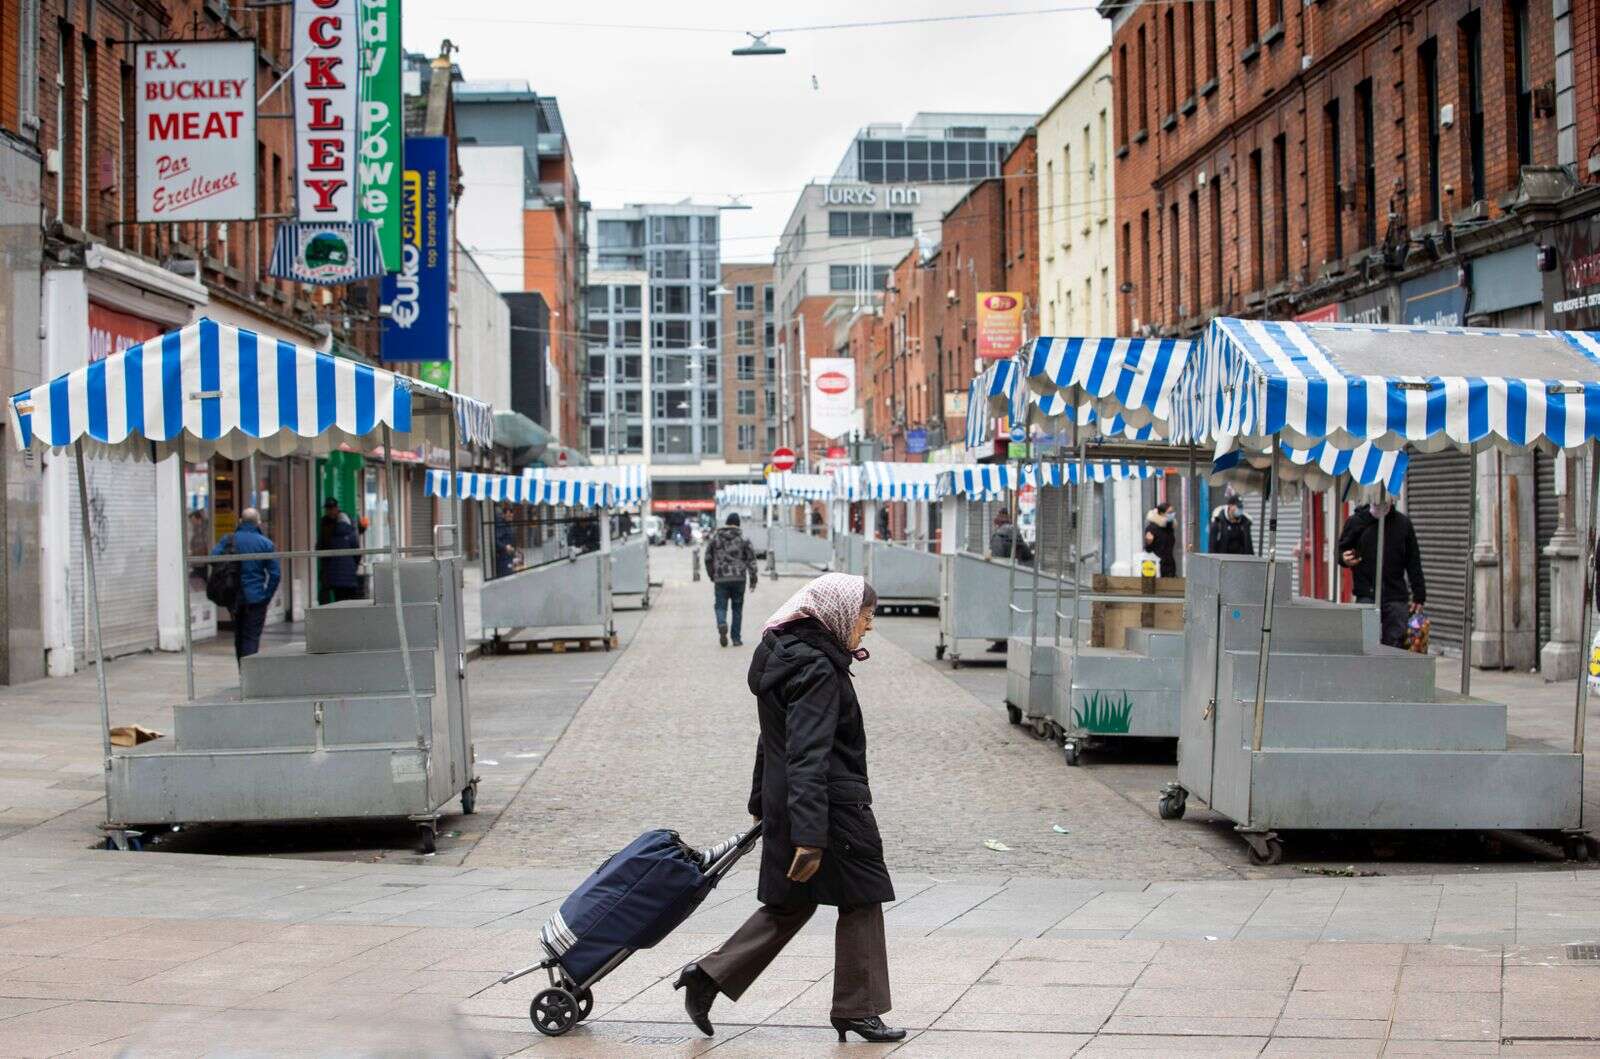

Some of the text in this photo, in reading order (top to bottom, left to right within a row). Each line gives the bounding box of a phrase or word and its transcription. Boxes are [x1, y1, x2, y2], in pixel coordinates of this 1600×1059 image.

[362, 0, 388, 77] dy
[145, 49, 187, 70] F.X.
[145, 77, 248, 101] BUCKLEY
[304, 0, 348, 212] CKLEY
[148, 111, 244, 140] MEAT
[156, 154, 190, 180] Par
[425, 170, 436, 190] less
[153, 171, 239, 213] Excellence
[425, 192, 437, 208] for
[819, 184, 921, 210] JURYS Inn
[426, 211, 437, 247] brands
